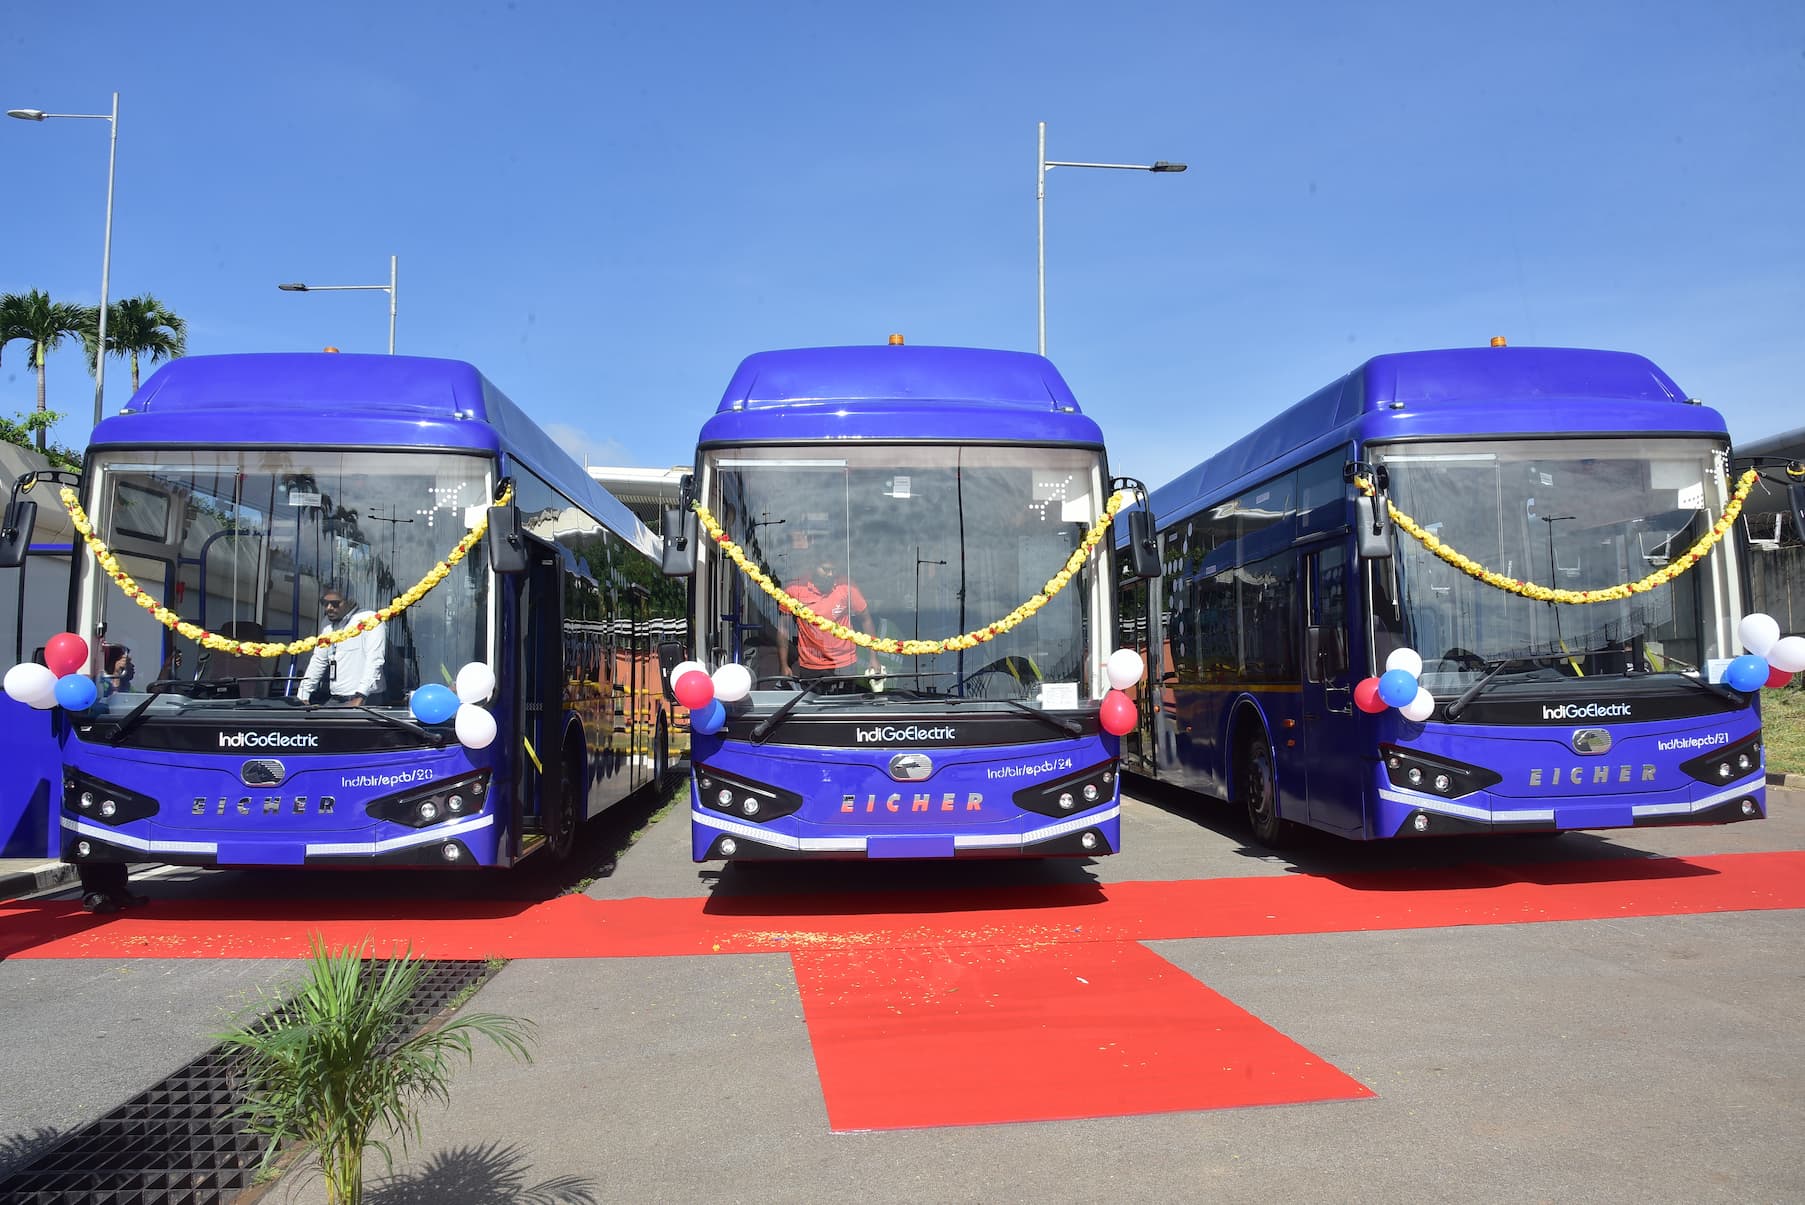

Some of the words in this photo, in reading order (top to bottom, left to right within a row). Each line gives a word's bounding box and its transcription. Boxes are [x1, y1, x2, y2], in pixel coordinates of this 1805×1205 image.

[1542, 703, 1632, 719] IndiGoElectric
[218, 731, 319, 748] IndiGoElectric
[856, 726, 956, 742] IndiGoElectric
[1529, 763, 1657, 786] EICHER
[191, 795, 337, 816] EICHER
[841, 792, 984, 813] EICHER
